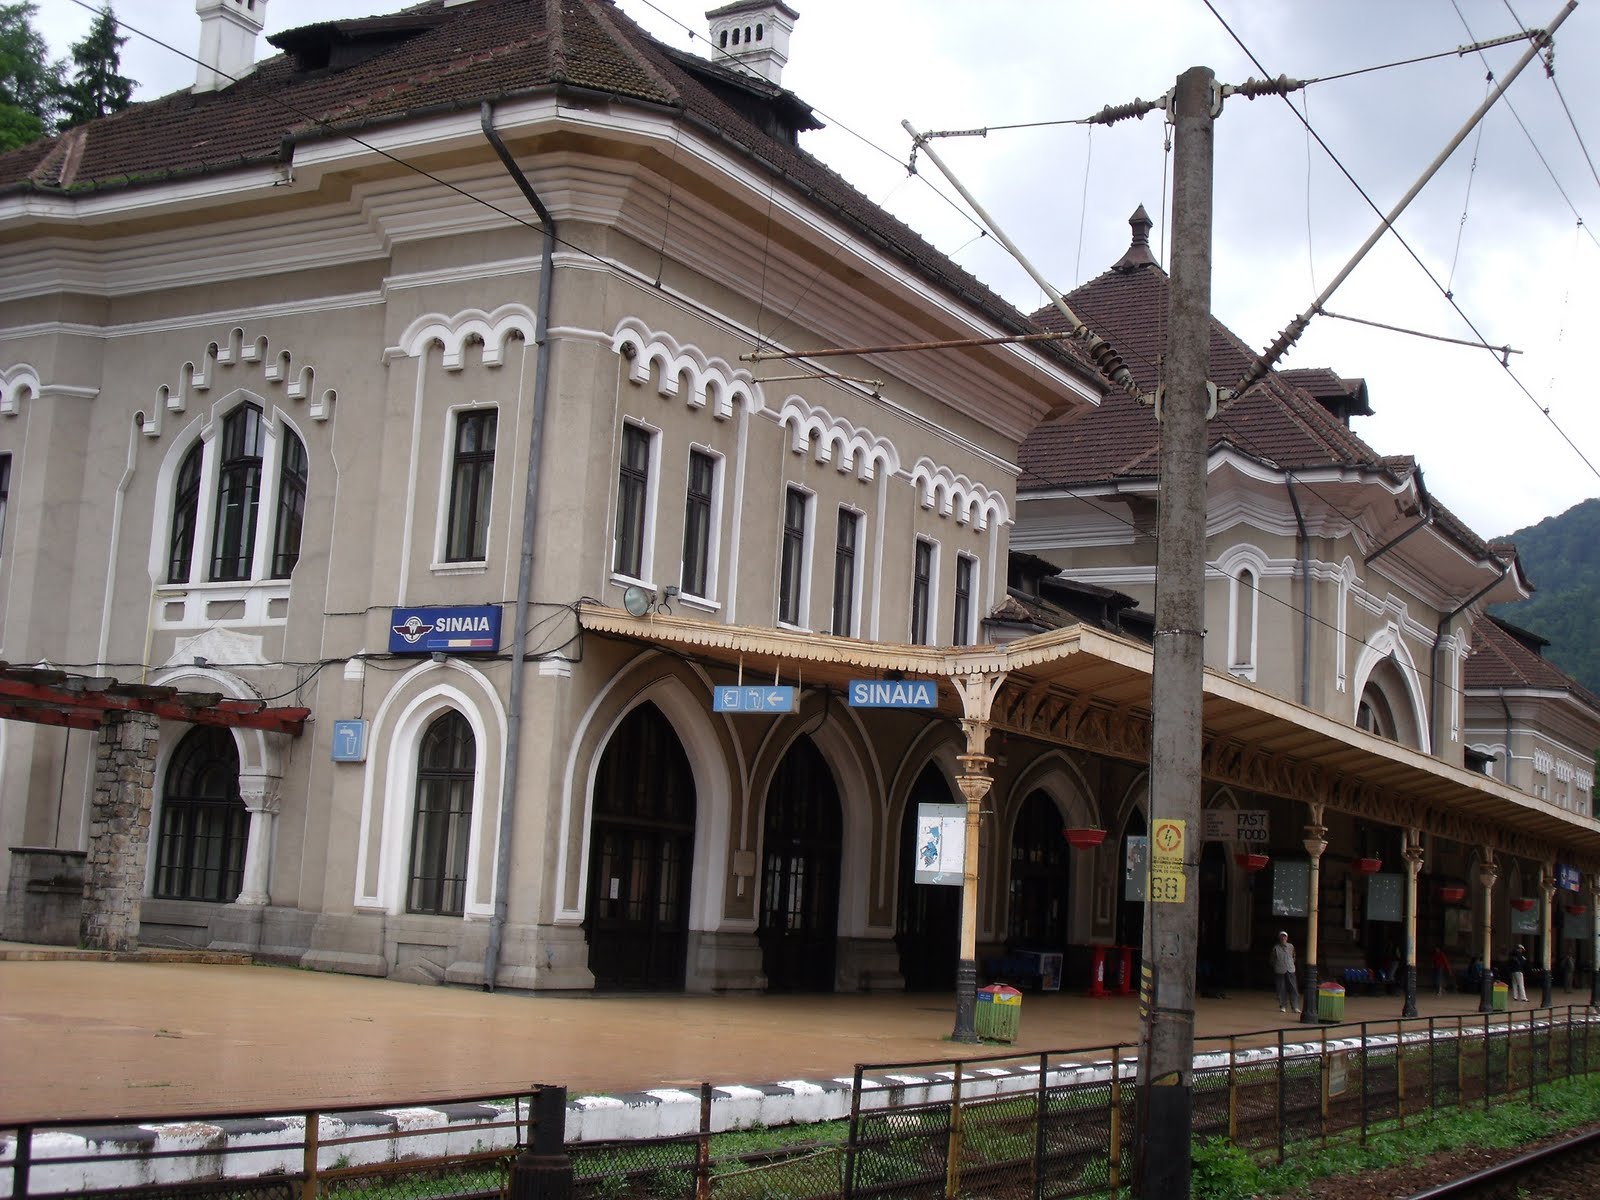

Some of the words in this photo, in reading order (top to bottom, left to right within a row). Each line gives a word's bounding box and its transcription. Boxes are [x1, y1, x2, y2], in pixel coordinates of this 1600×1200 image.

[435, 616, 490, 632] SINAIA
[854, 683, 930, 705] SINAIA
[1237, 813, 1266, 825] FAST
[1237, 828, 1267, 840] FOOD
